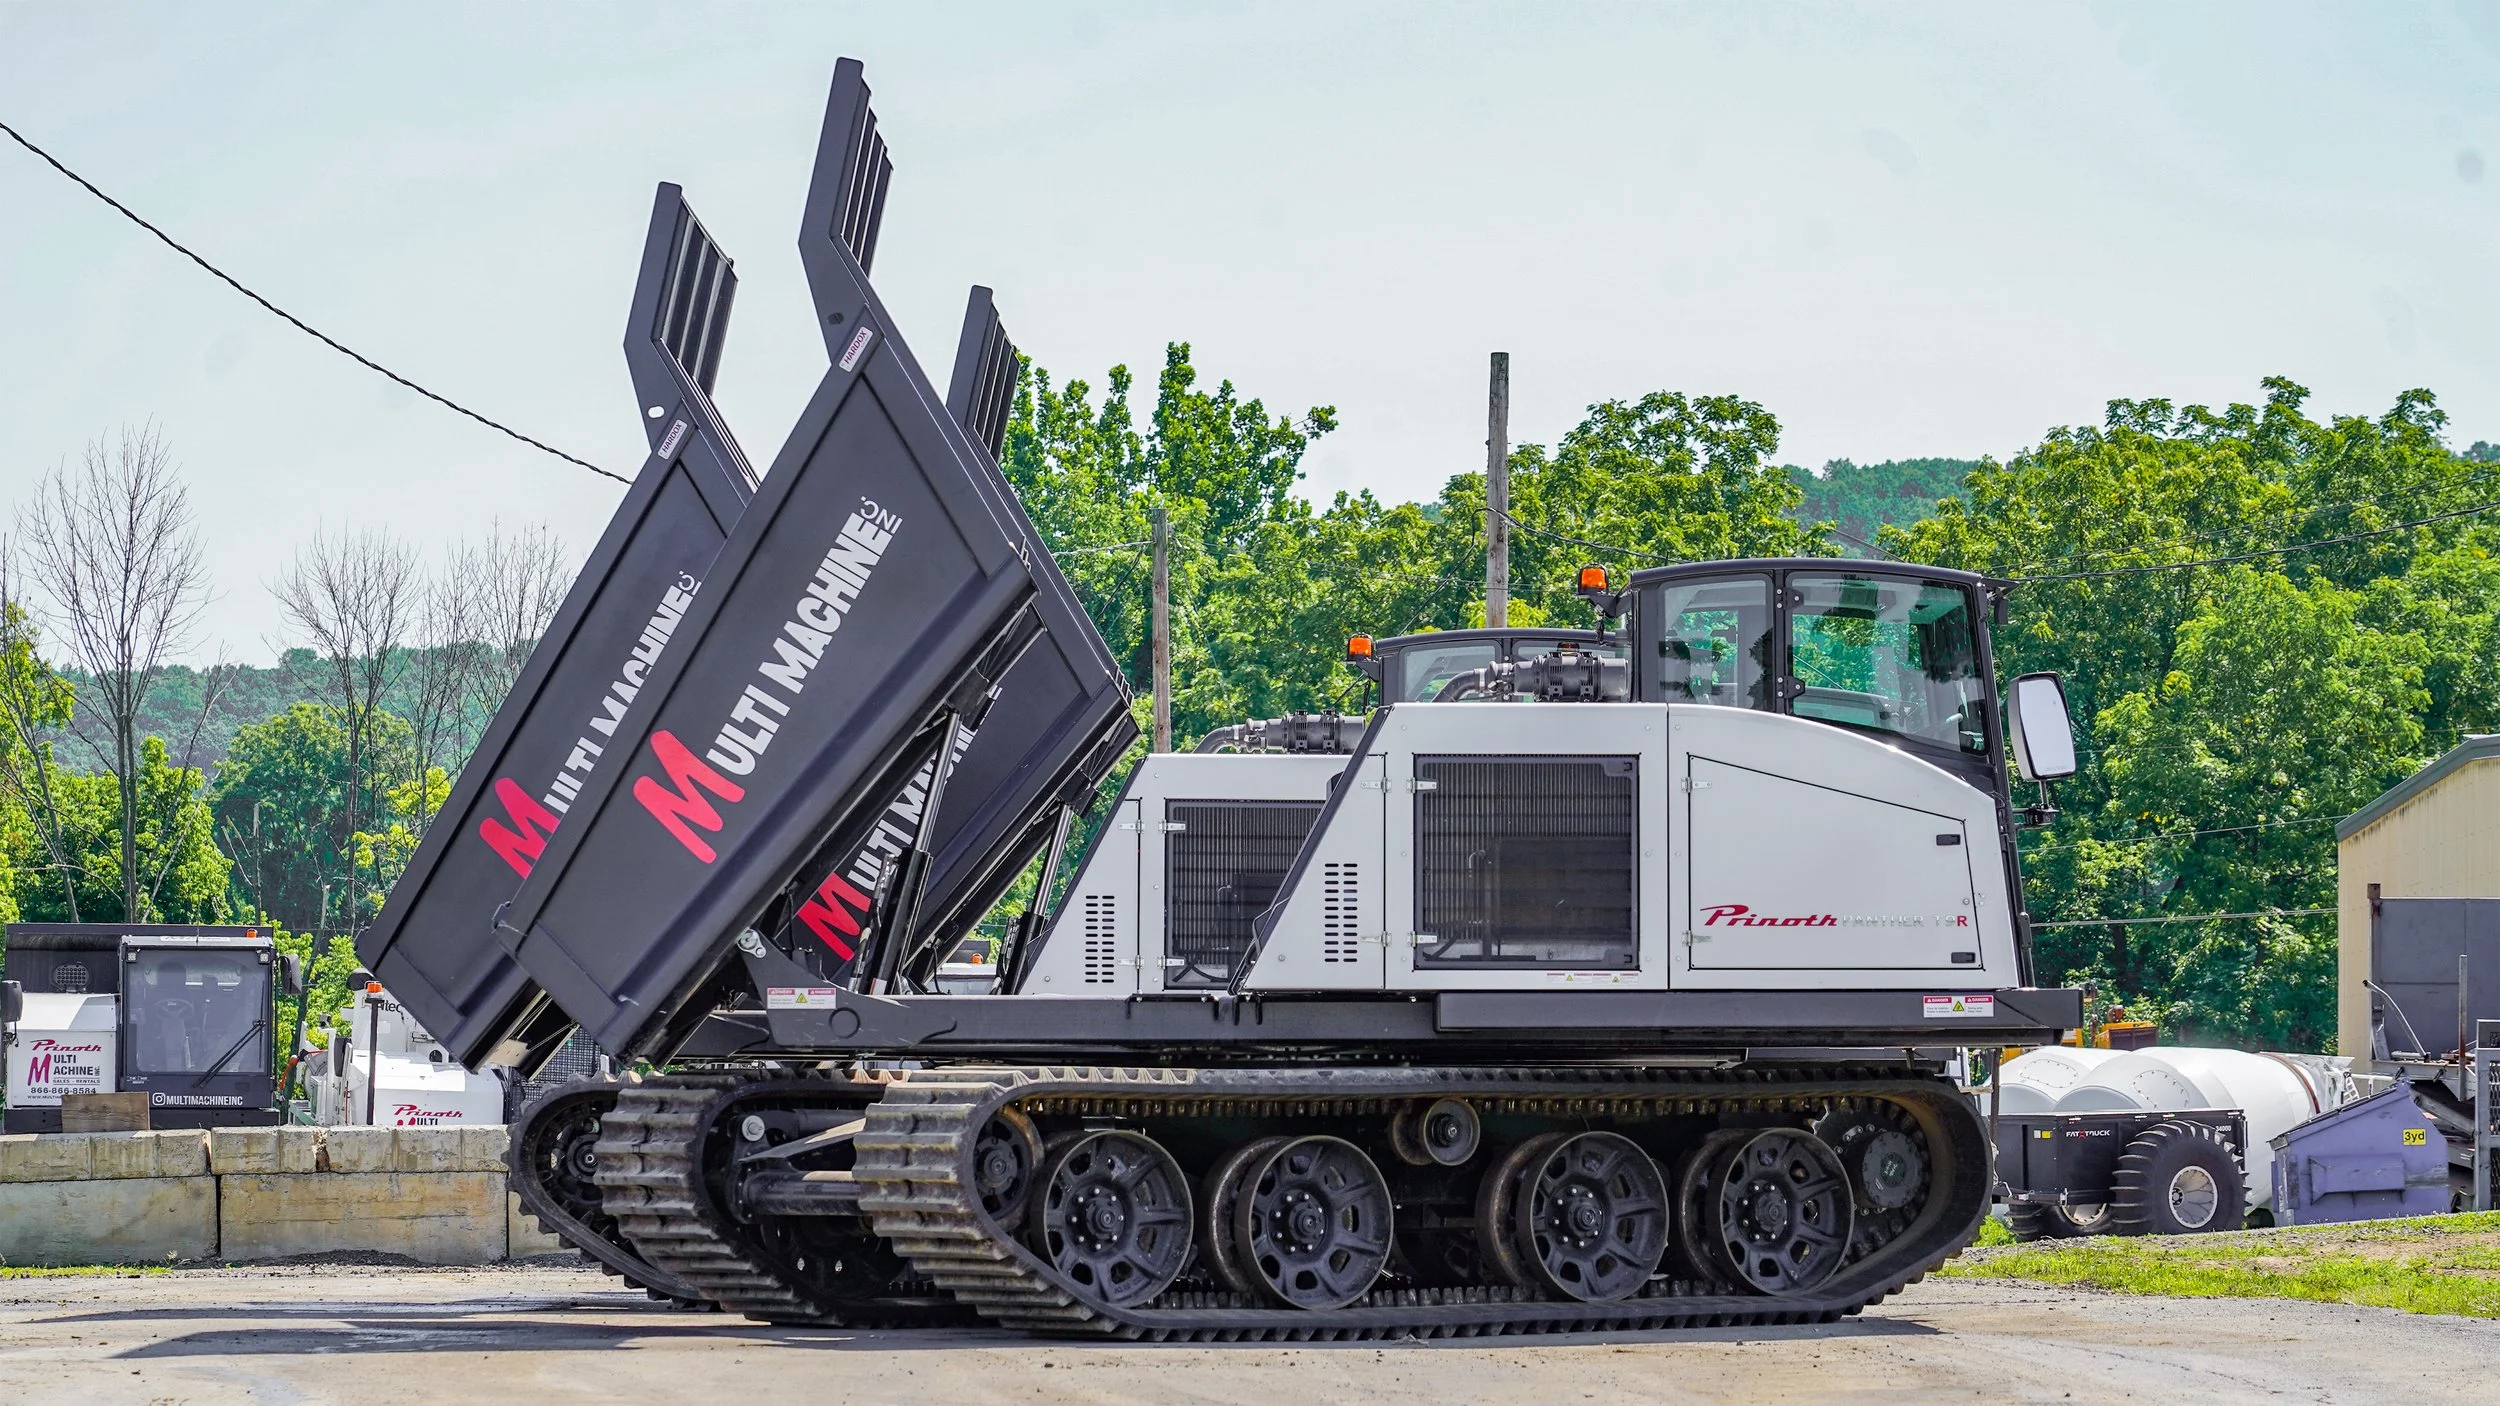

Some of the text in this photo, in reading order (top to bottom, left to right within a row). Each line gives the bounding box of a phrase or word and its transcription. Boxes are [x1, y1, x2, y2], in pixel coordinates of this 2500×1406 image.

[844, 330, 867, 364] HARDOX
[662, 423, 682, 453] HARDOX
[633, 684, 791, 864] MULTI
[758, 512, 894, 694] MACHINE
[1700, 904, 1838, 927] Prinoth
[30, 1039, 102, 1052] Prinoth
[30, 1087, 97, 1095] 866-866-8584
[166, 1095, 243, 1106] MULTIMACHINEINC
[392, 1104, 463, 1117] Prinoth
[2404, 1131, 2425, 1143] 3yd
